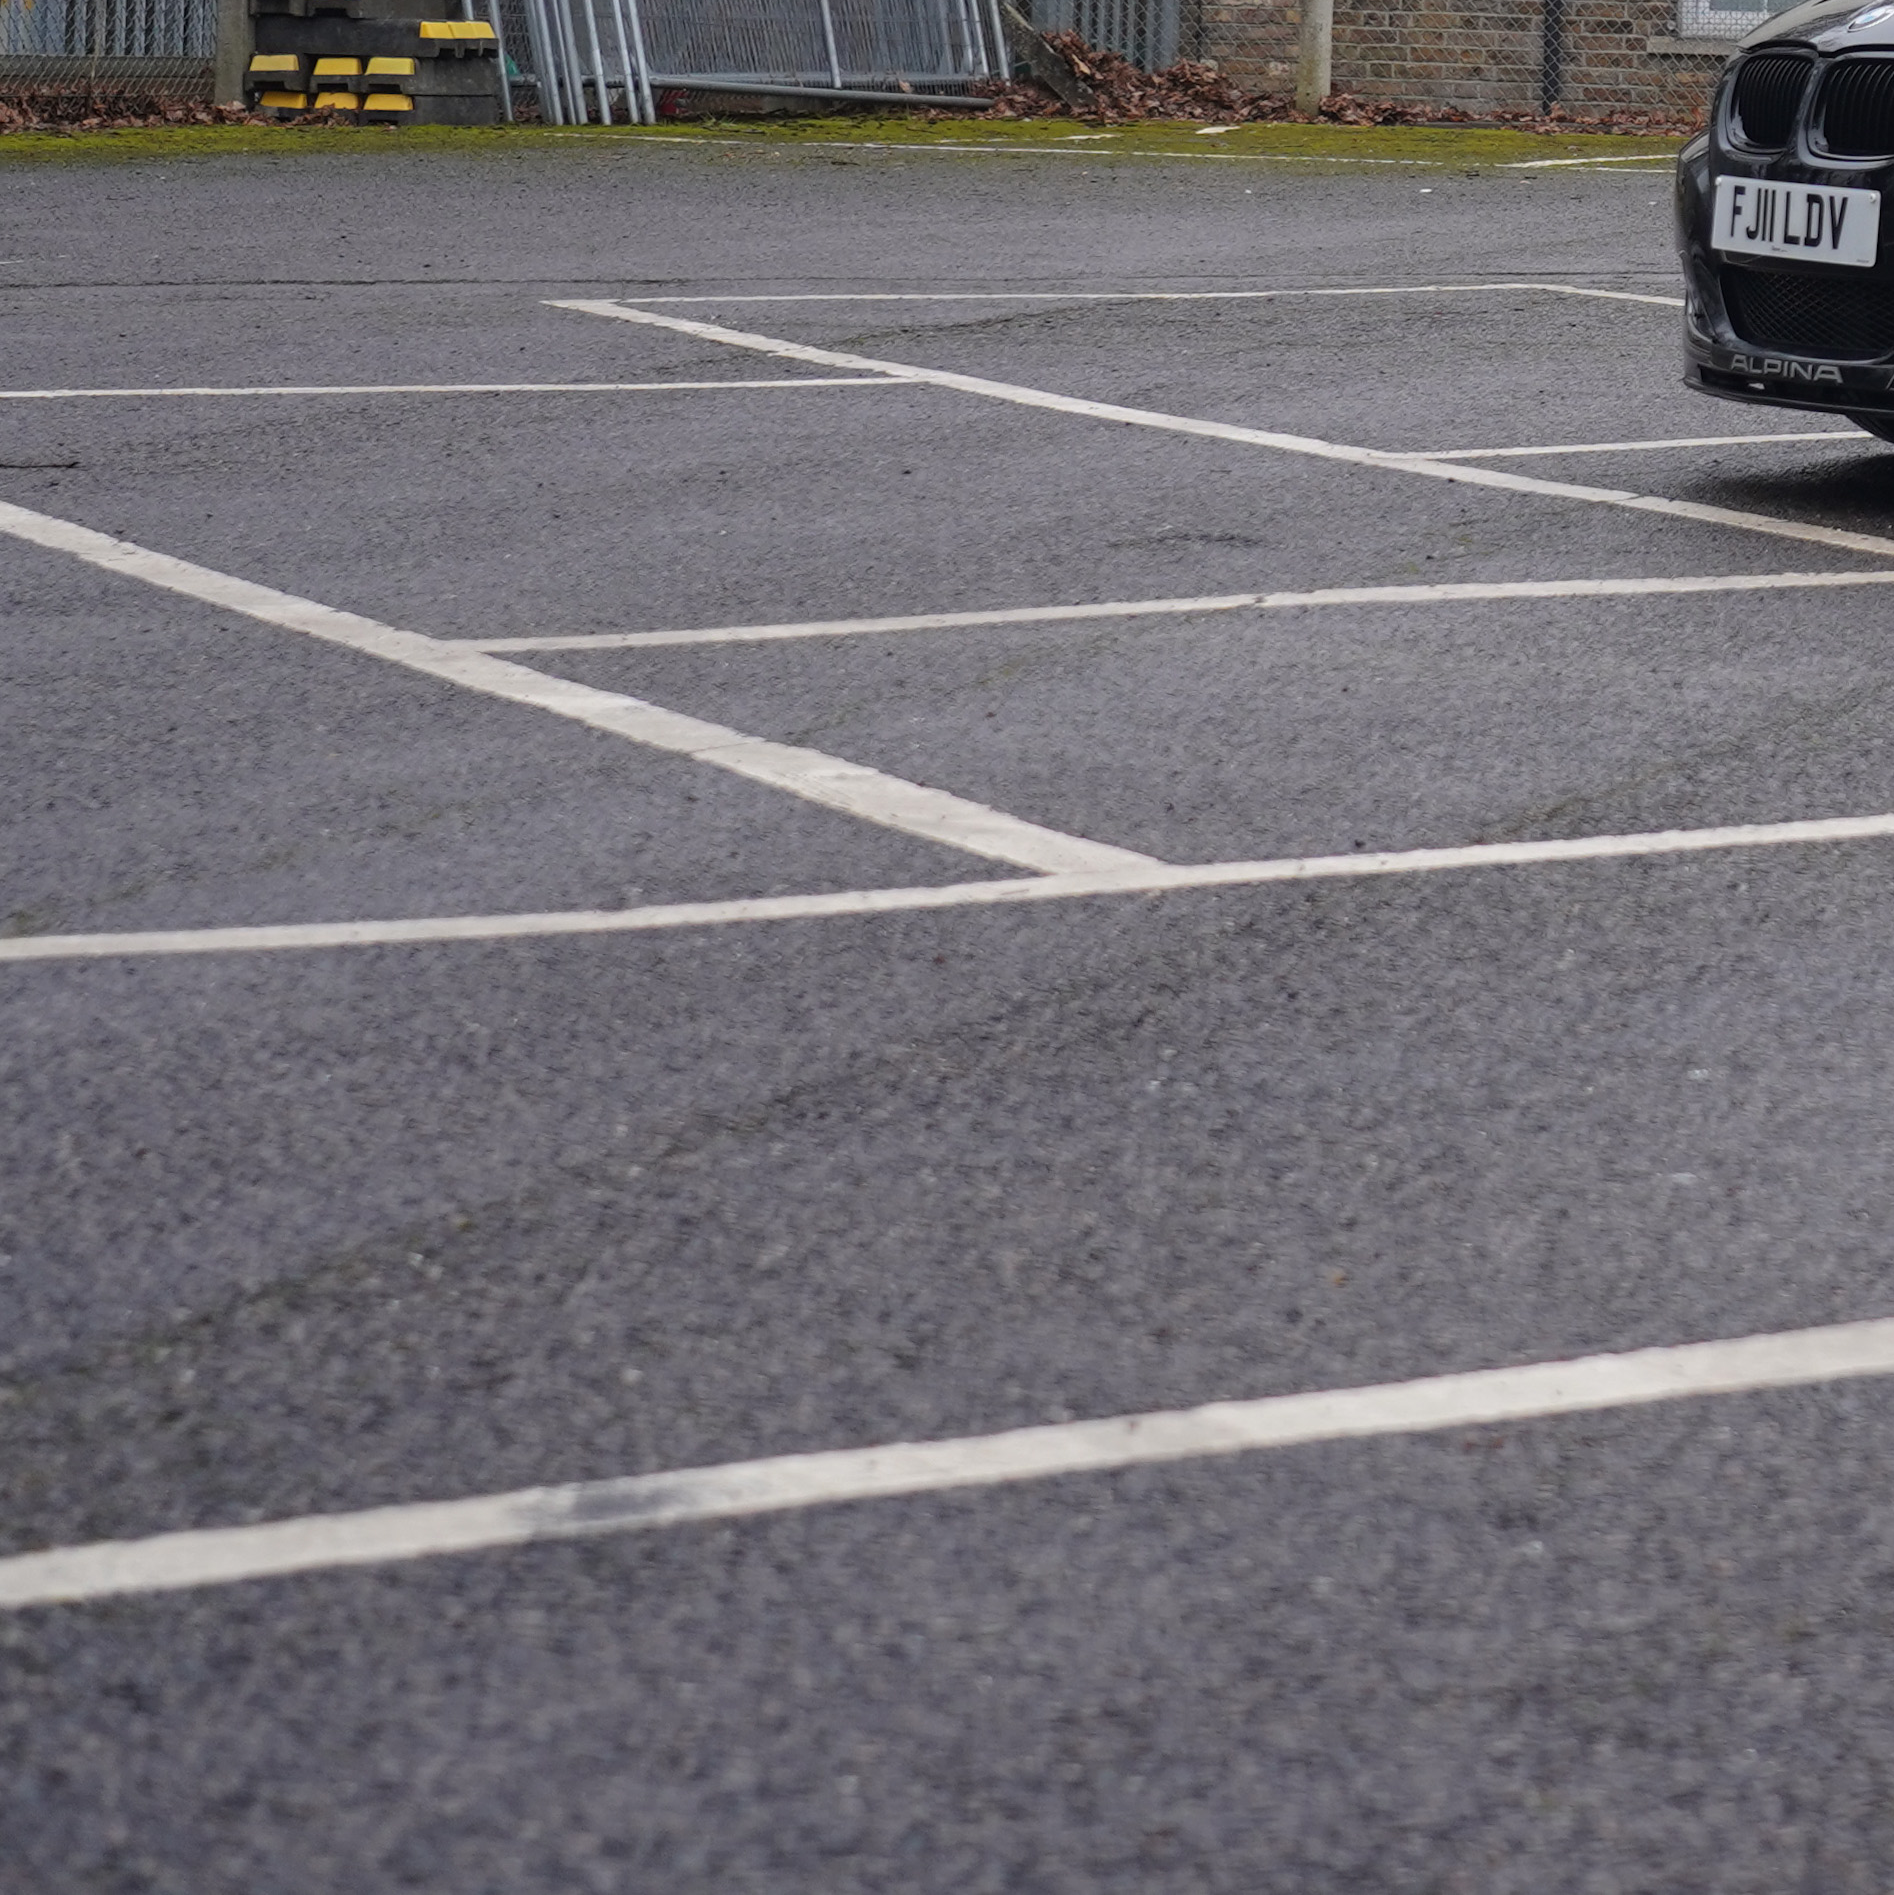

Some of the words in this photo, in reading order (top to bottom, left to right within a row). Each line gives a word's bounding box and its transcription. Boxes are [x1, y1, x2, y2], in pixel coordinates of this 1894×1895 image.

[1730, 185, 1777, 243] FJ11
[1783, 191, 1848, 250] LDV
[1730, 354, 1844, 385] ALPINA
